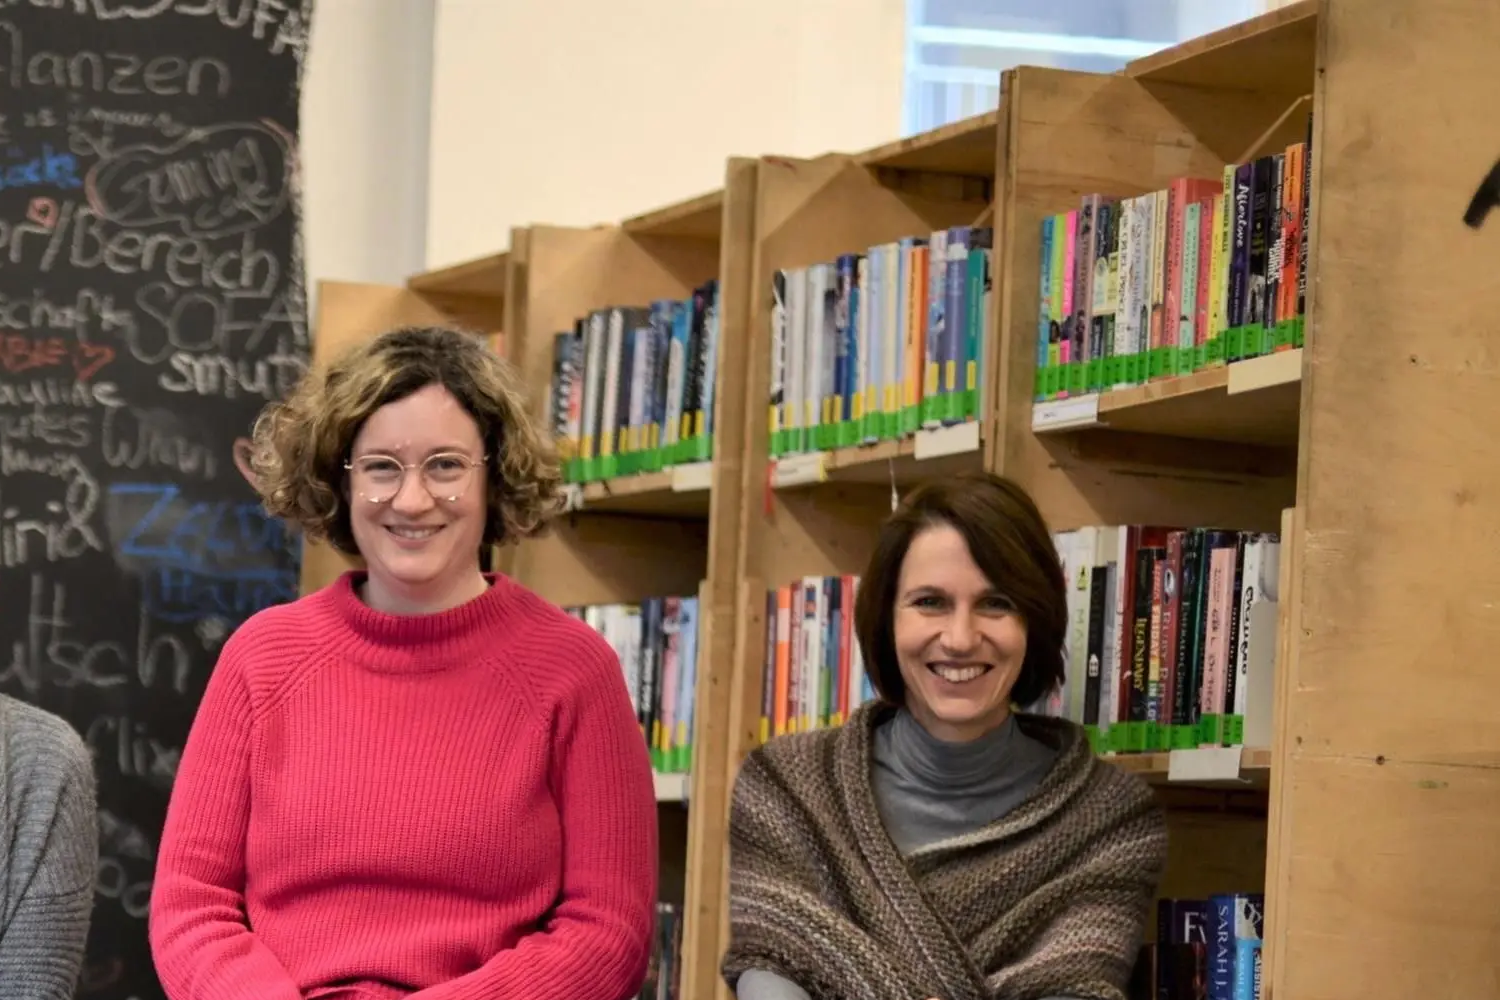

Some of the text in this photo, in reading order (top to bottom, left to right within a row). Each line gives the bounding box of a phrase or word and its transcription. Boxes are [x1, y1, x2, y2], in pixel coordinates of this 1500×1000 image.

[1236, 184, 1249, 248] Afterlove
[1133, 618, 1148, 692] LEGENDARY
[1150, 604, 1161, 657] FRIDAY
[1216, 905, 1229, 972] SARAH
[1214, 980, 1228, 990] J.
